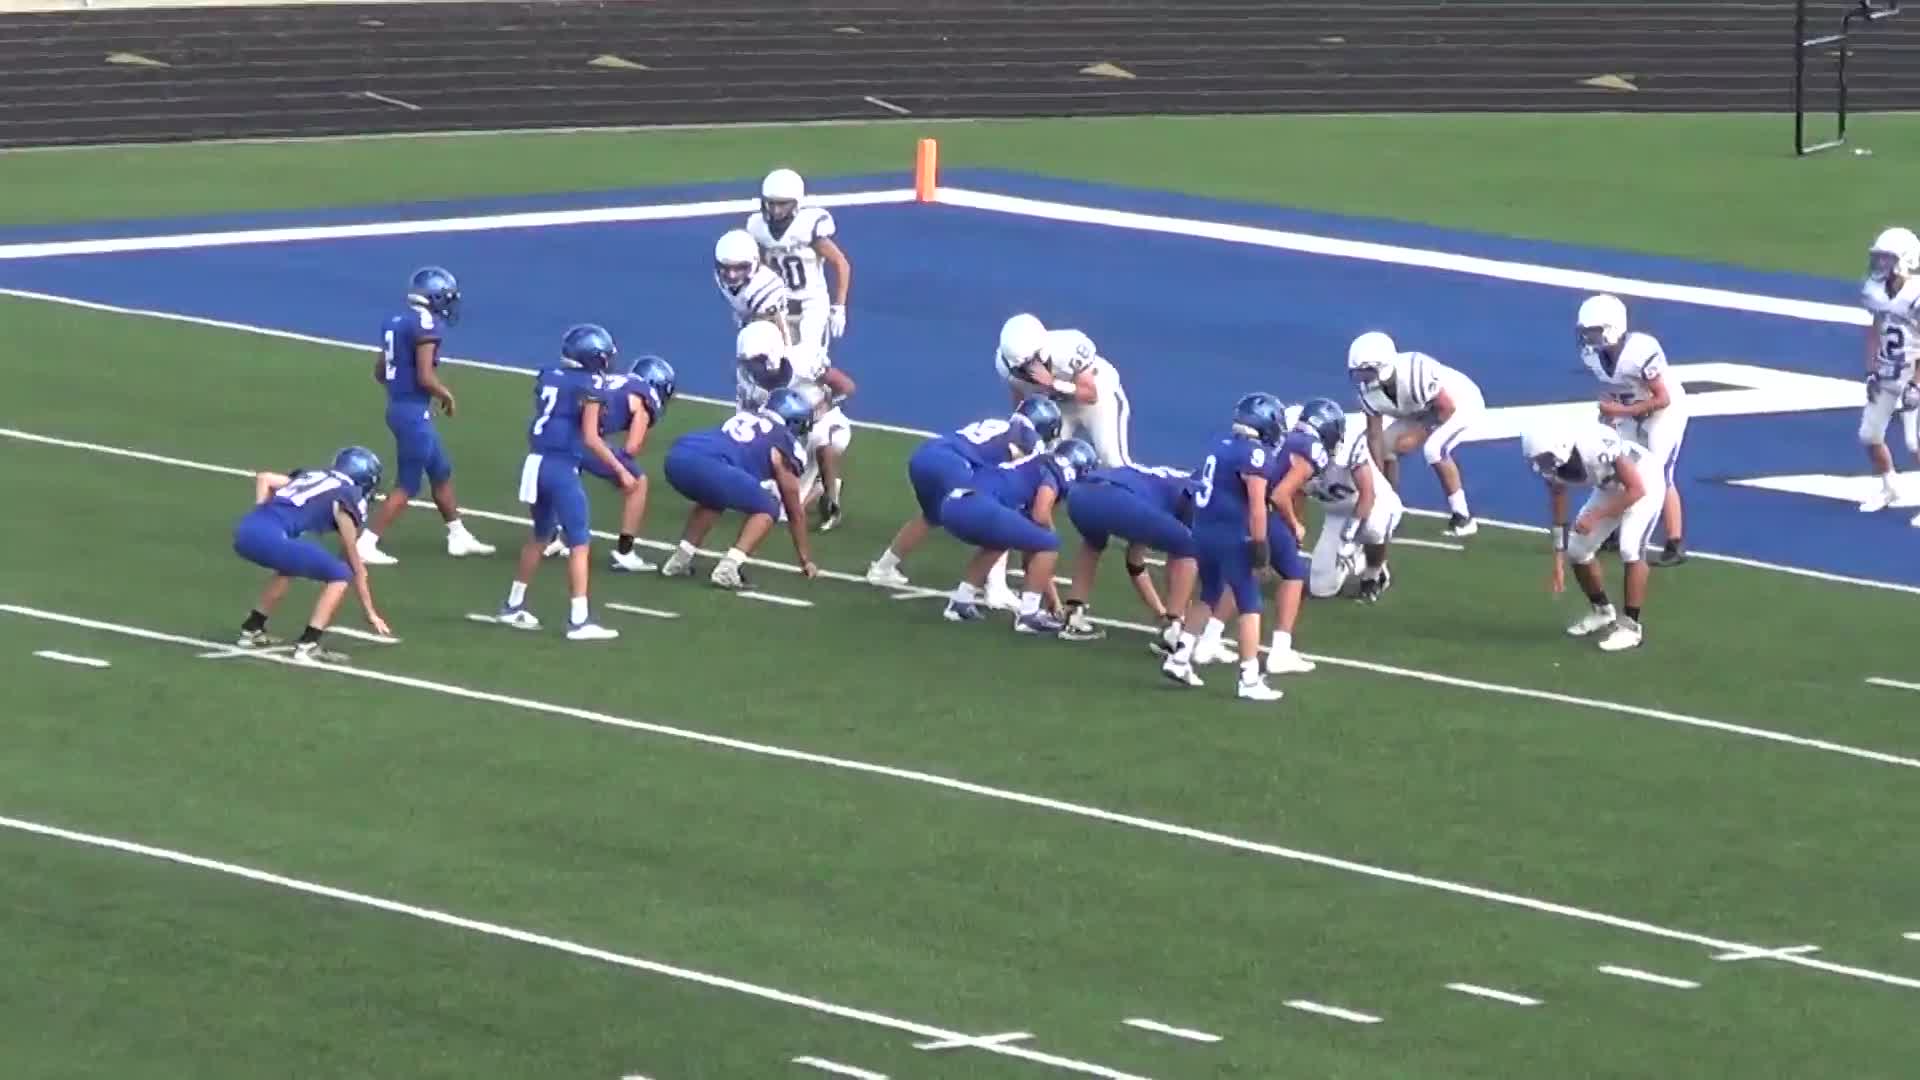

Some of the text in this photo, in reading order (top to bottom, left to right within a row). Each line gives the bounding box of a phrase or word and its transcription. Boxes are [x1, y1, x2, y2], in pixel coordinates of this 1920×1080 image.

[532, 386, 558, 435] 7
[1195, 454, 1217, 509] 9
[1249, 448, 1266, 468] 9
